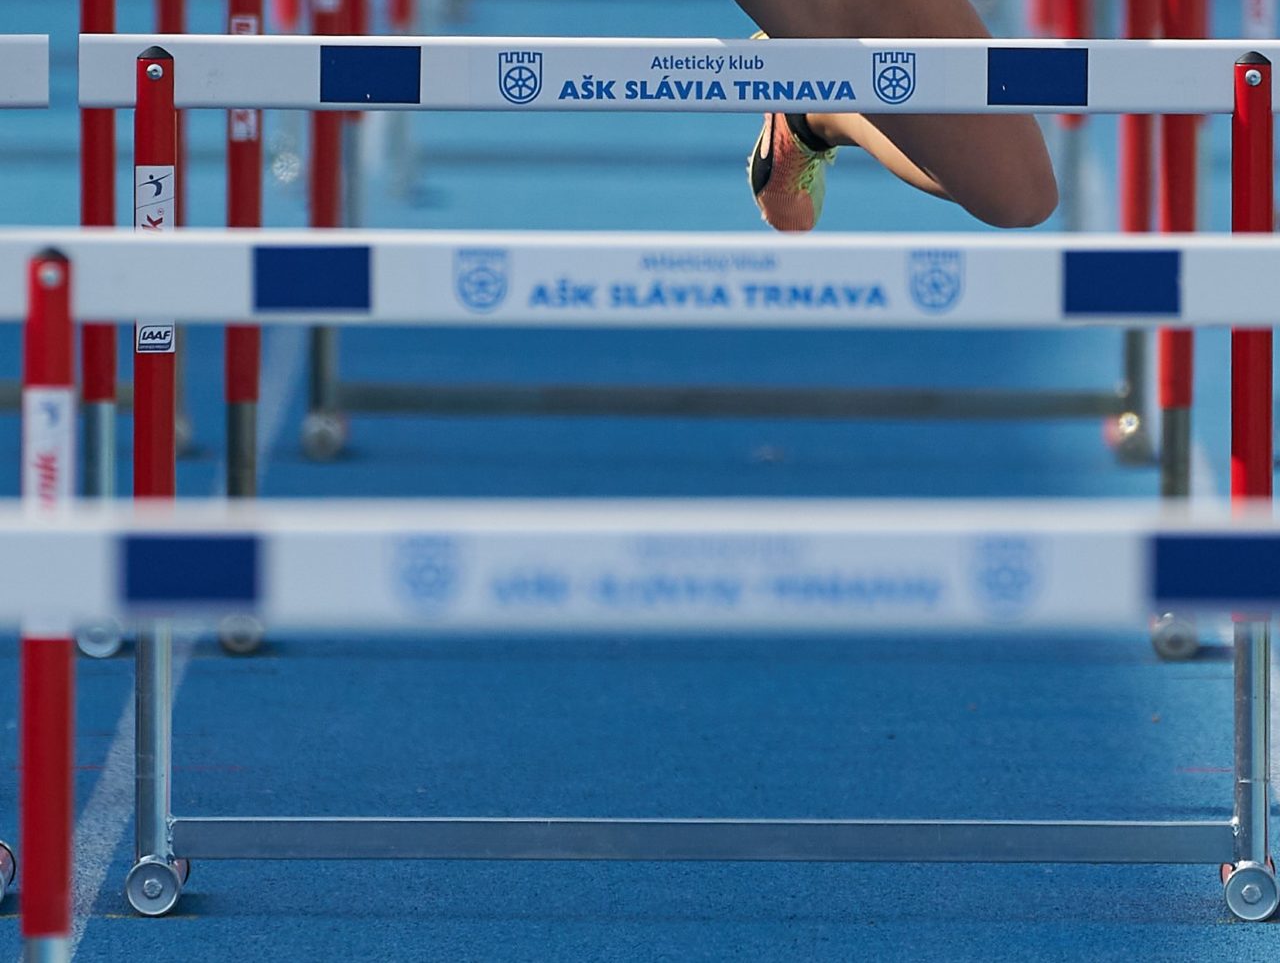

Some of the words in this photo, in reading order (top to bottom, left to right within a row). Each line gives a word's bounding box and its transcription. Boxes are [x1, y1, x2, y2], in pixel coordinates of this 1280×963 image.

[650, 55, 725, 73] Atletický
[729, 55, 764, 70] klub
[558, 75, 616, 100] AŠK
[625, 75, 727, 100] SLÁVIA
[734, 80, 856, 100] TRNAVA
[529, 278, 597, 308] AŠK
[608, 280, 731, 308] SLÁVIA
[742, 283, 888, 308] TRNAVA
[142, 330, 171, 340] IAAF
